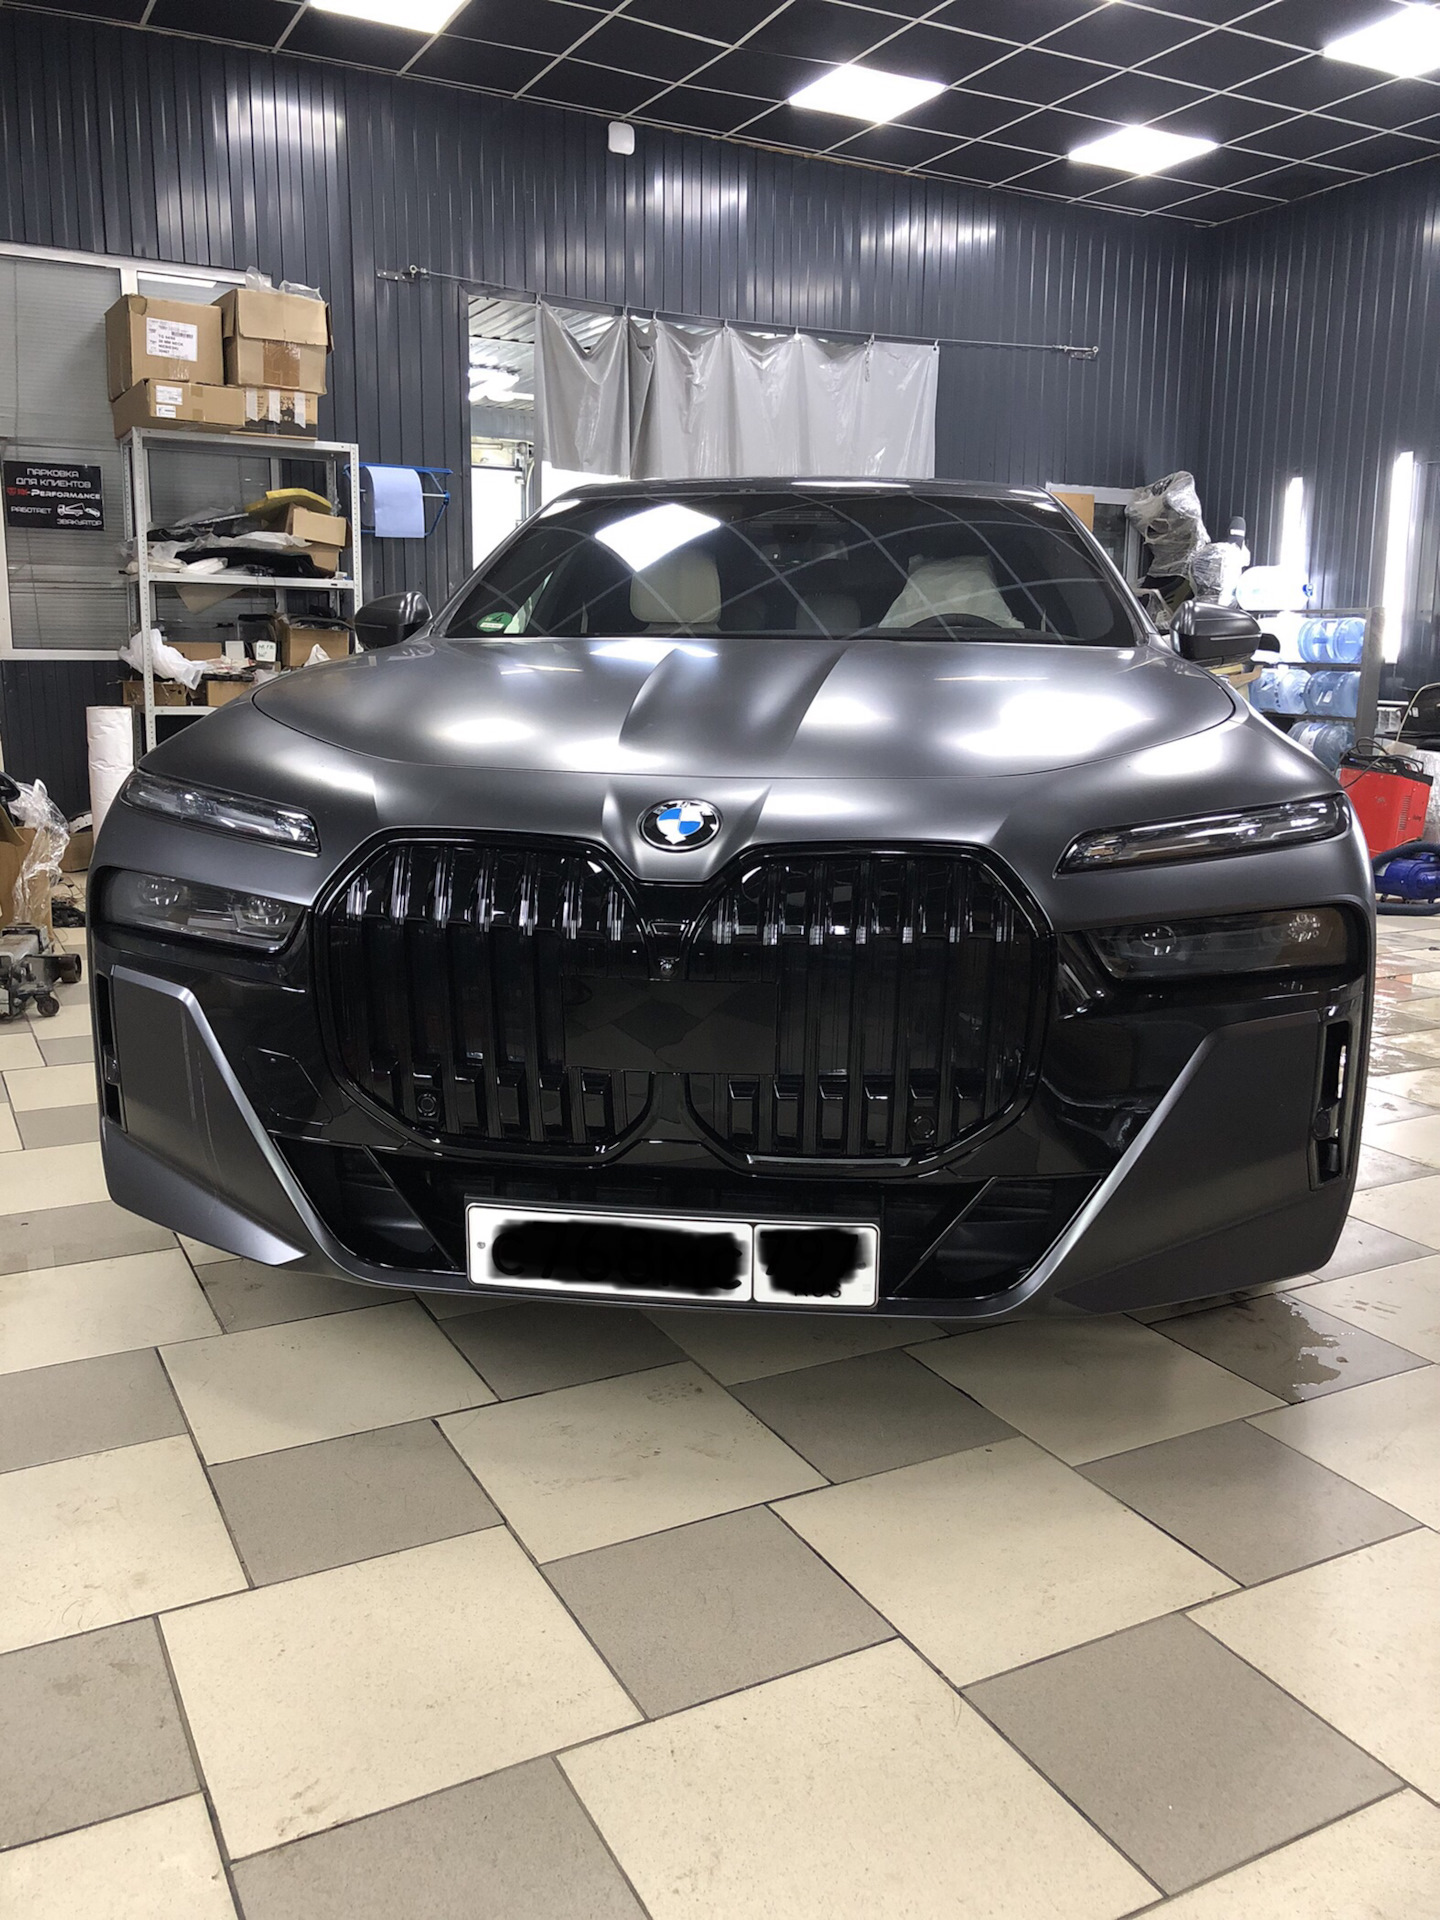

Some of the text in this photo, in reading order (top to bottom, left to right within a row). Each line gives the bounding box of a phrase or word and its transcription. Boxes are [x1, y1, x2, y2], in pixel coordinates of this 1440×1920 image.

[27, 468, 79, 478] ПАРКОВКА
[40, 479, 91, 488] КЛИЕНТОВ
[10, 506, 52, 514] РАБОТАЕТ
